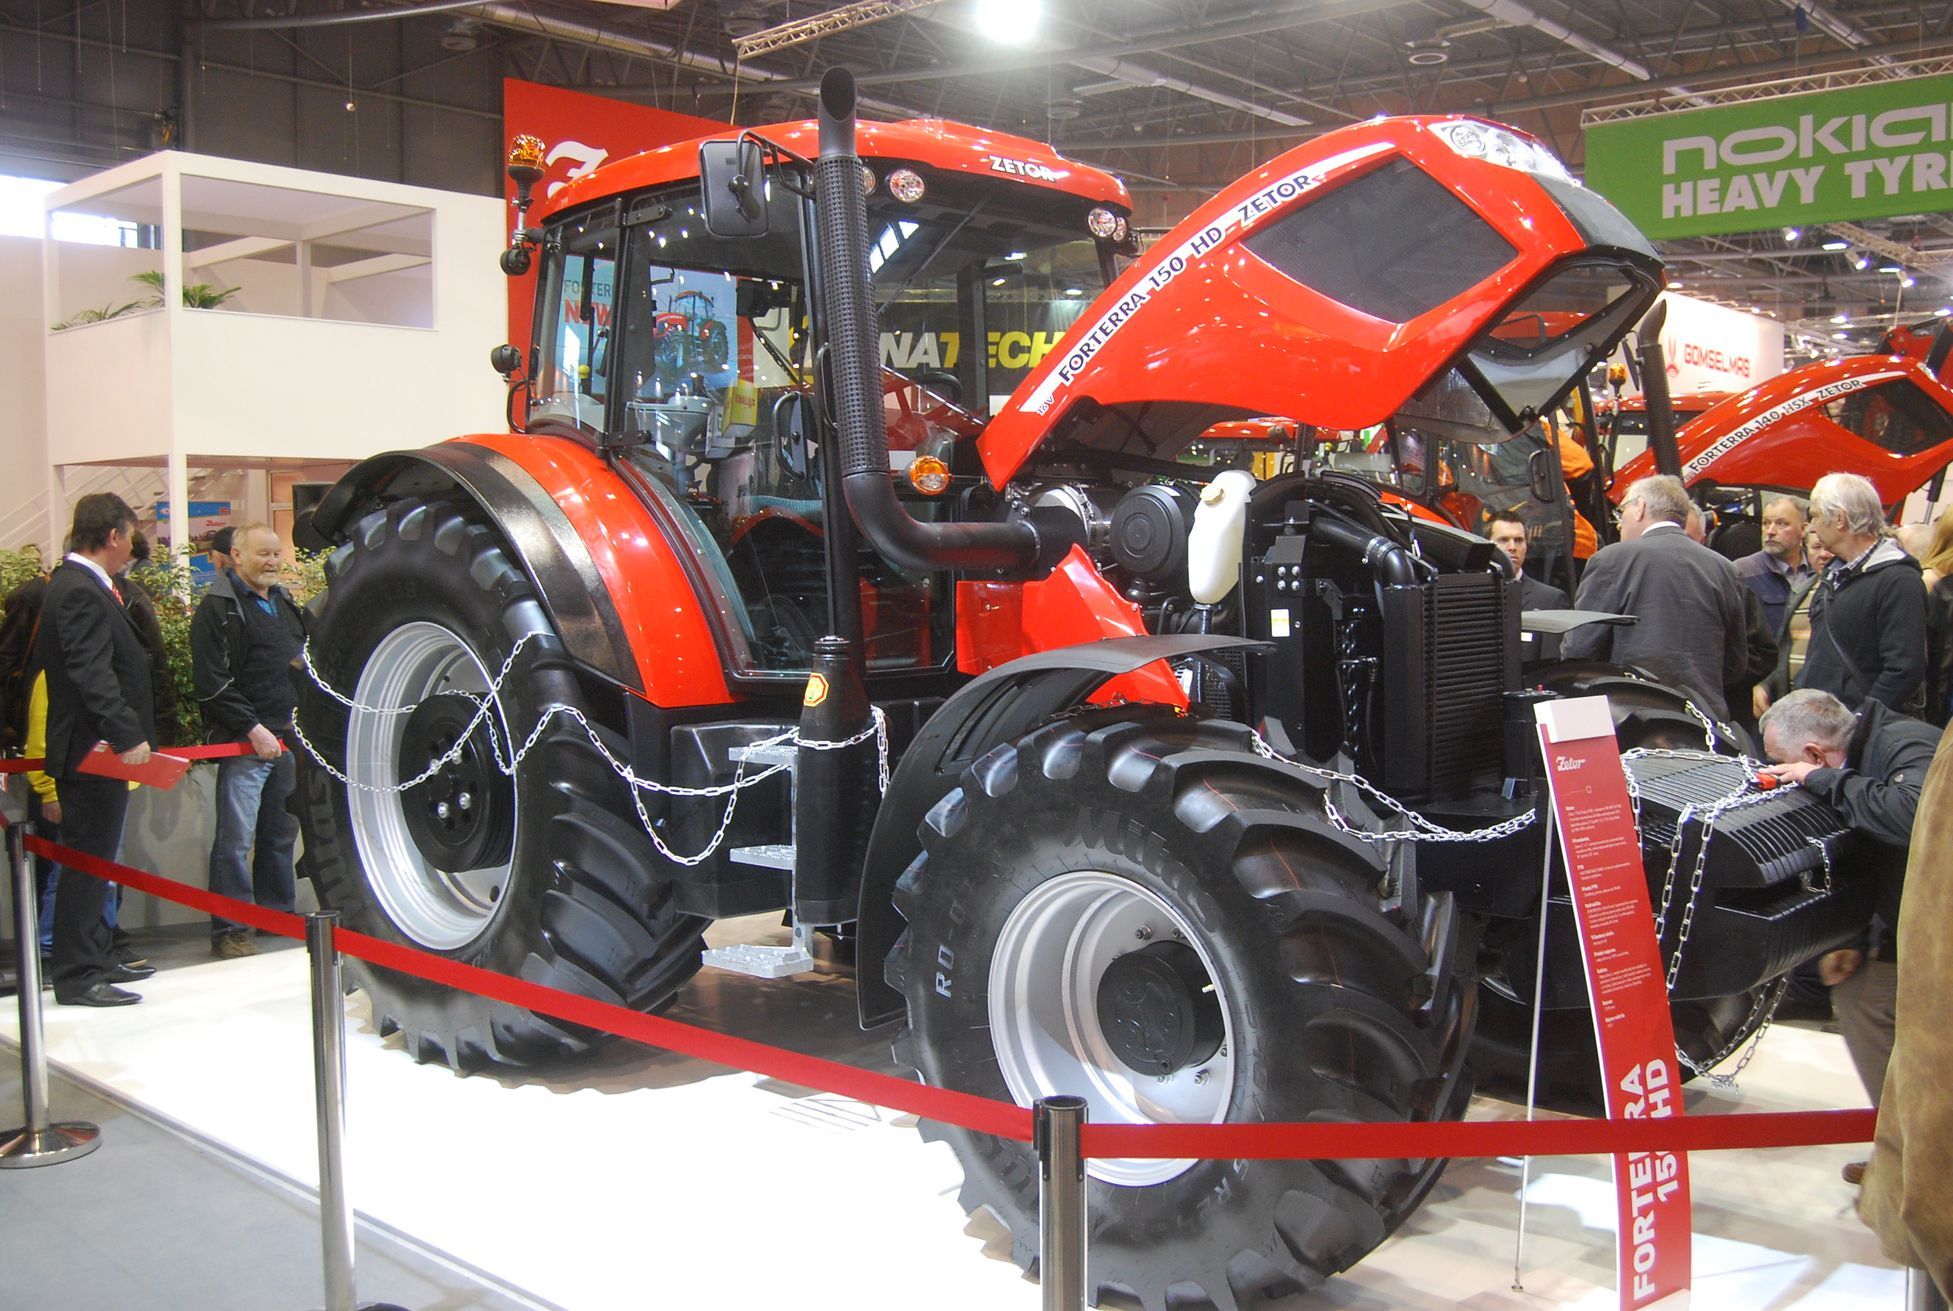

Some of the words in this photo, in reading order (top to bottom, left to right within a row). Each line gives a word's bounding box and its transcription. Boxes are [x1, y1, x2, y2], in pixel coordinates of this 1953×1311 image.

[988, 155, 1057, 183] ZETOR
[1662, 165, 1827, 219] HEAVY
[1844, 151, 1953, 200] TYR
[1058, 292, 1147, 383] FORTERRA
[1149, 255, 1184, 288] 150
[1190, 226, 1223, 256] HD
[1238, 174, 1312, 223] ZETOR
[1684, 343, 1750, 379] GOMSELMAS
[1689, 426, 1755, 473] FORTERRA
[1756, 410, 1781, 430] 140
[1782, 396, 1811, 416] HSX
[1817, 378, 1863, 400] ZETOR
[1556, 755, 1587, 772] Zetor
[1645, 1058, 1672, 1120] HD
[1620, 1063, 1656, 1300] FORTERA
[1656, 1150, 1679, 1202] 15
